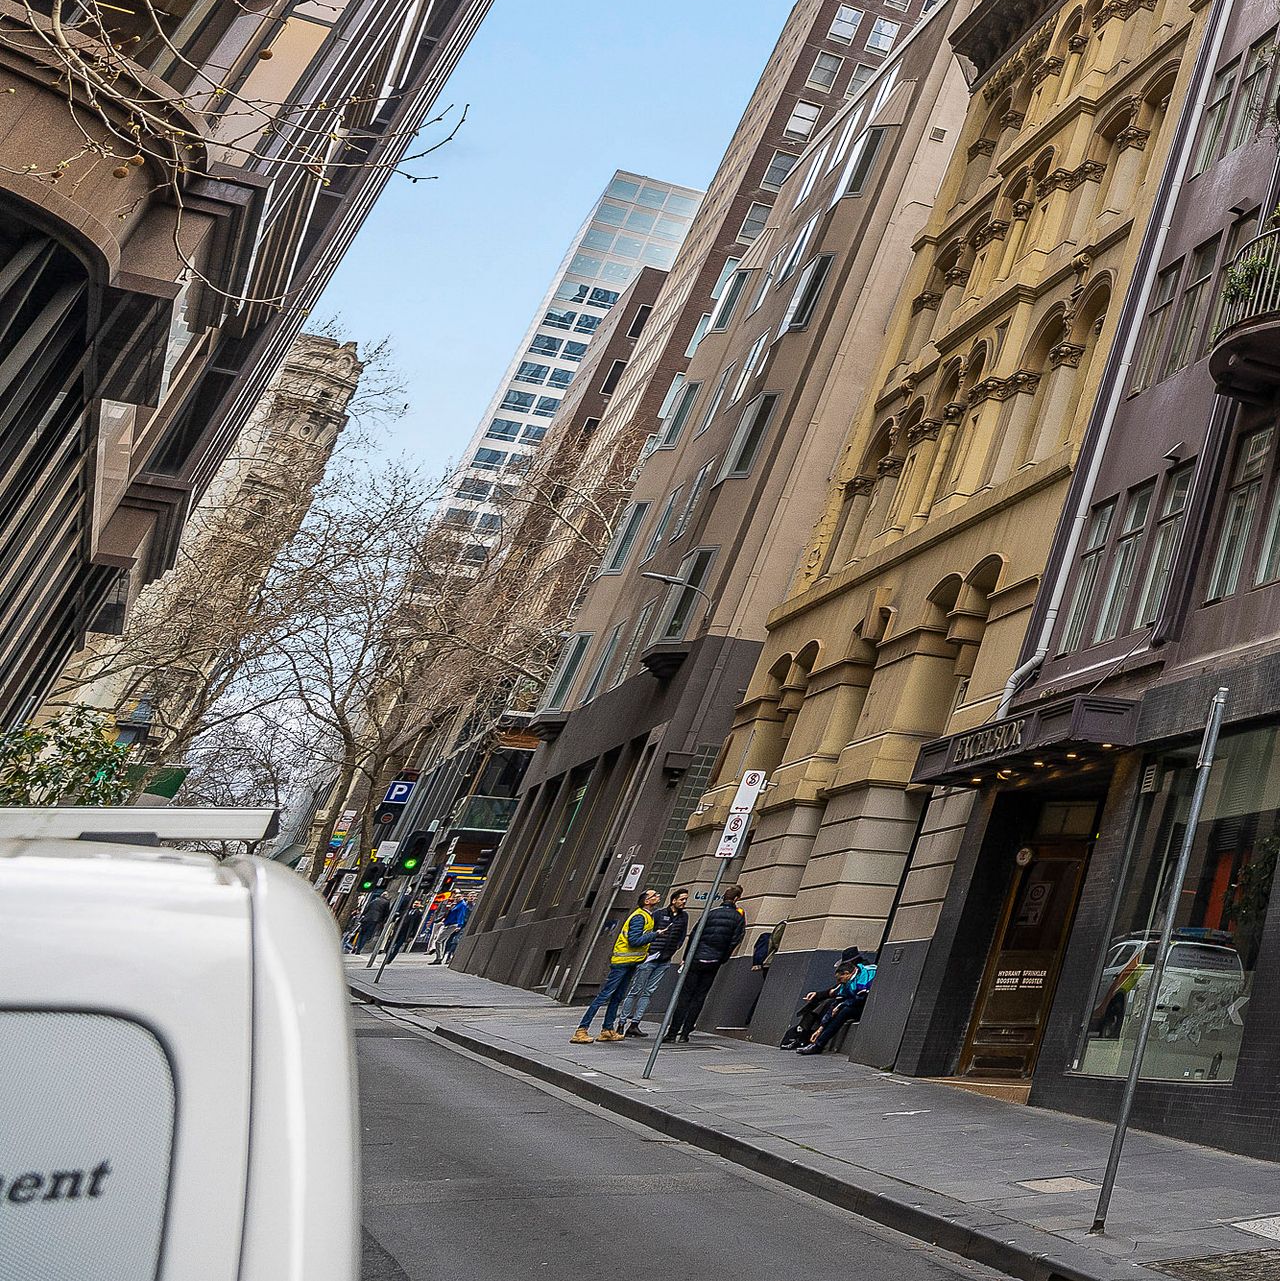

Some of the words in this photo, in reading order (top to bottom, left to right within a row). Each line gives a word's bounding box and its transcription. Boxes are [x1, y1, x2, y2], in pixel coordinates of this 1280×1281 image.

[953, 720, 1026, 763] EXCELSIOR
[389, 784, 408, 801] P
[0, 1158, 113, 1203] ent
